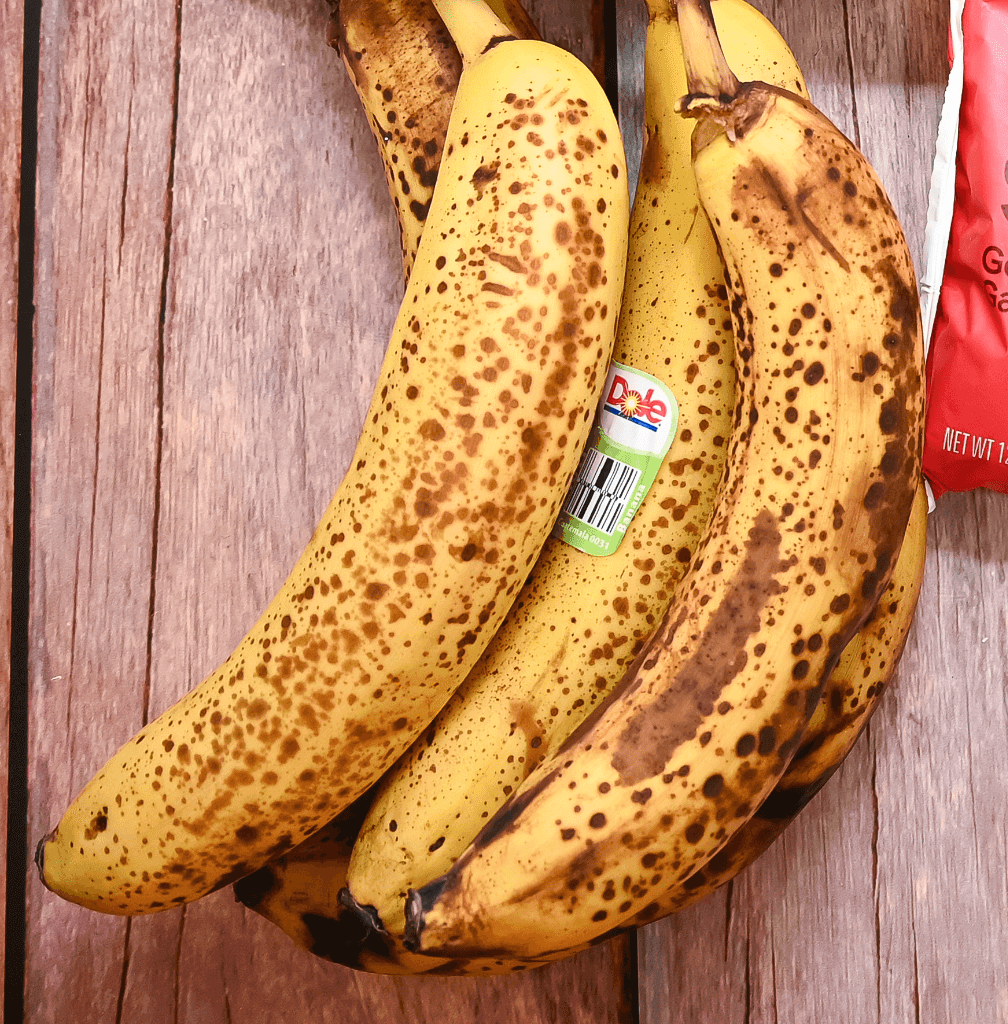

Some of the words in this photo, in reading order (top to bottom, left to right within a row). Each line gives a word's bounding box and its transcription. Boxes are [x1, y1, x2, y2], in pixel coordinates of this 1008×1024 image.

[606, 375, 668, 424] Dole
[943, 427, 970, 455] NET
[972, 435, 995, 461] WT
[617, 484, 646, 533] Banana
